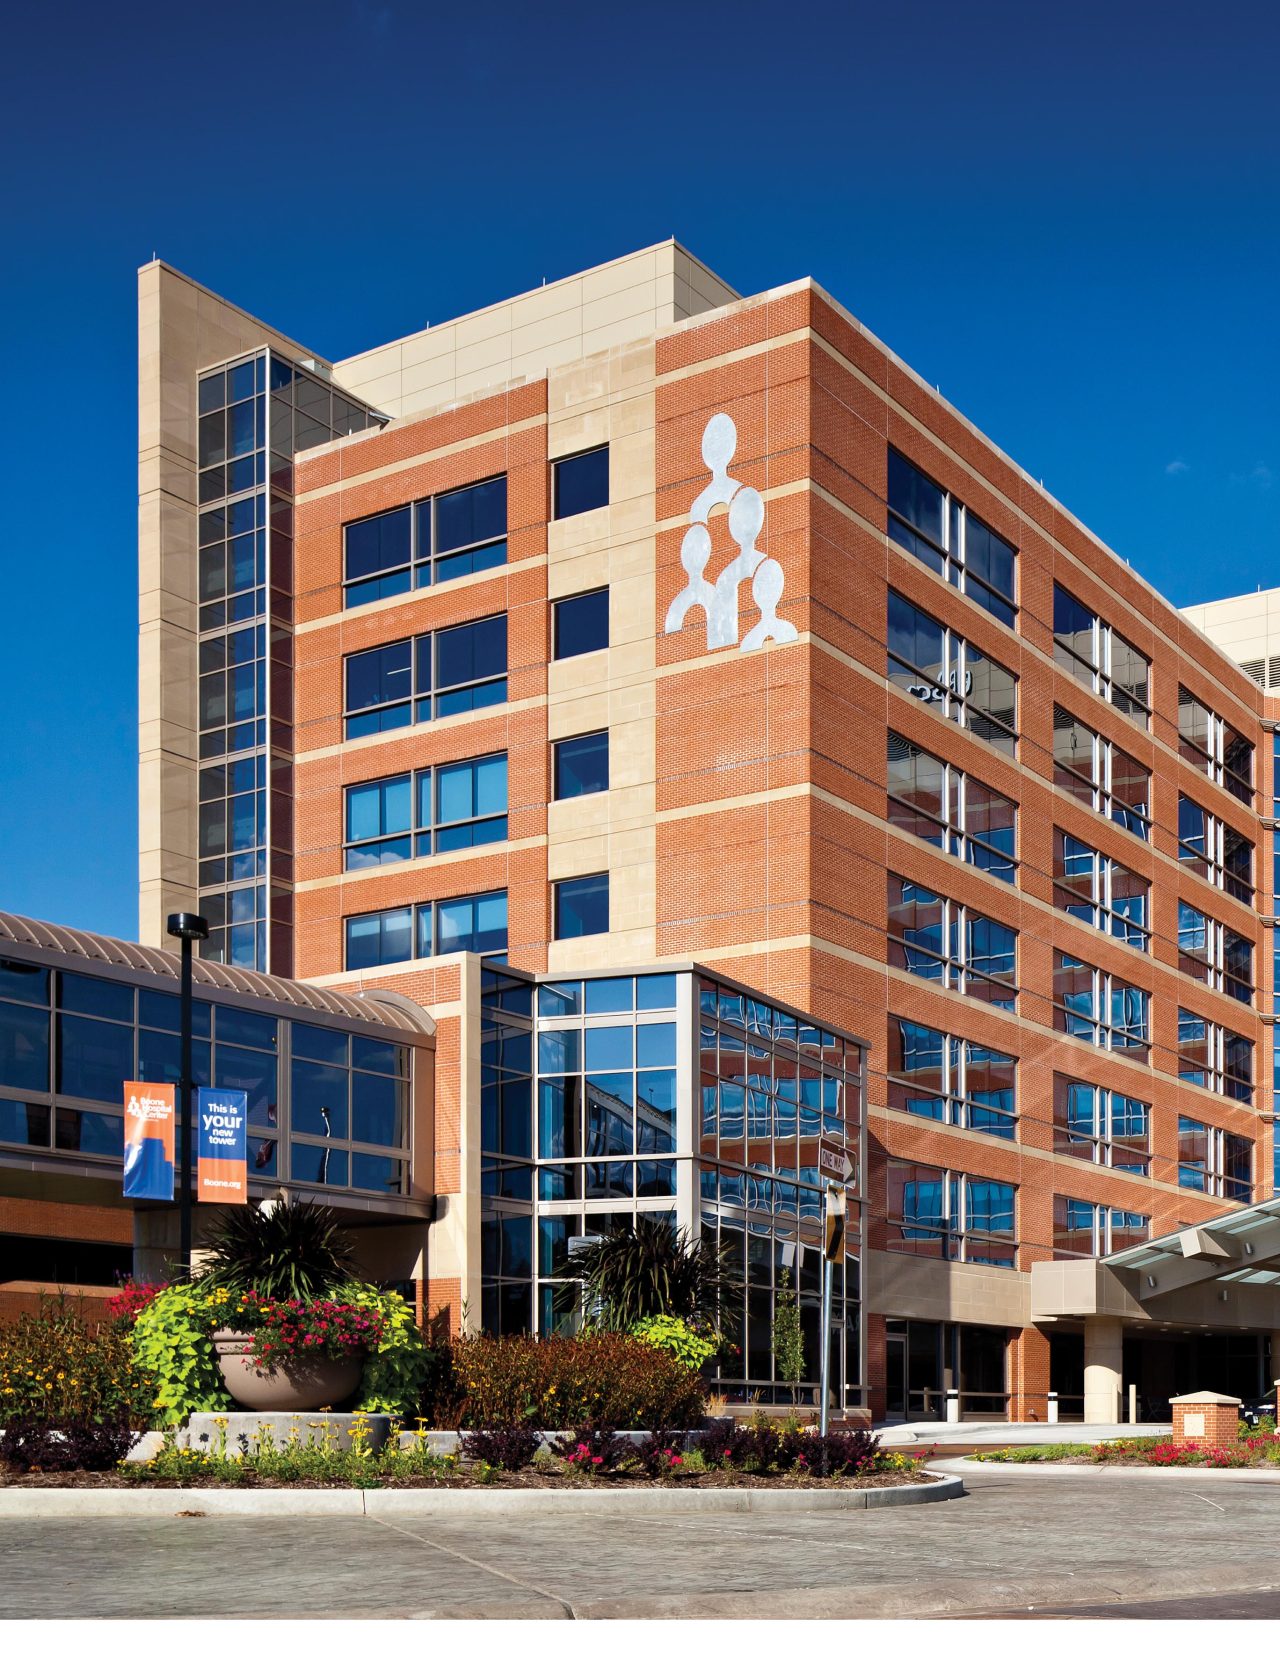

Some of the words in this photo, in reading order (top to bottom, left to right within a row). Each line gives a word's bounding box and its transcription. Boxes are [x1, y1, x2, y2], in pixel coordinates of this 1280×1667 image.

[208, 1103, 228, 1114] This
[229, 1105, 238, 1114] is
[202, 1114, 243, 1131] your
[212, 1128, 234, 1138] new
[208, 1135, 237, 1146] tower
[822, 1150, 833, 1168] ONE
[833, 1156, 845, 1173] WAY
